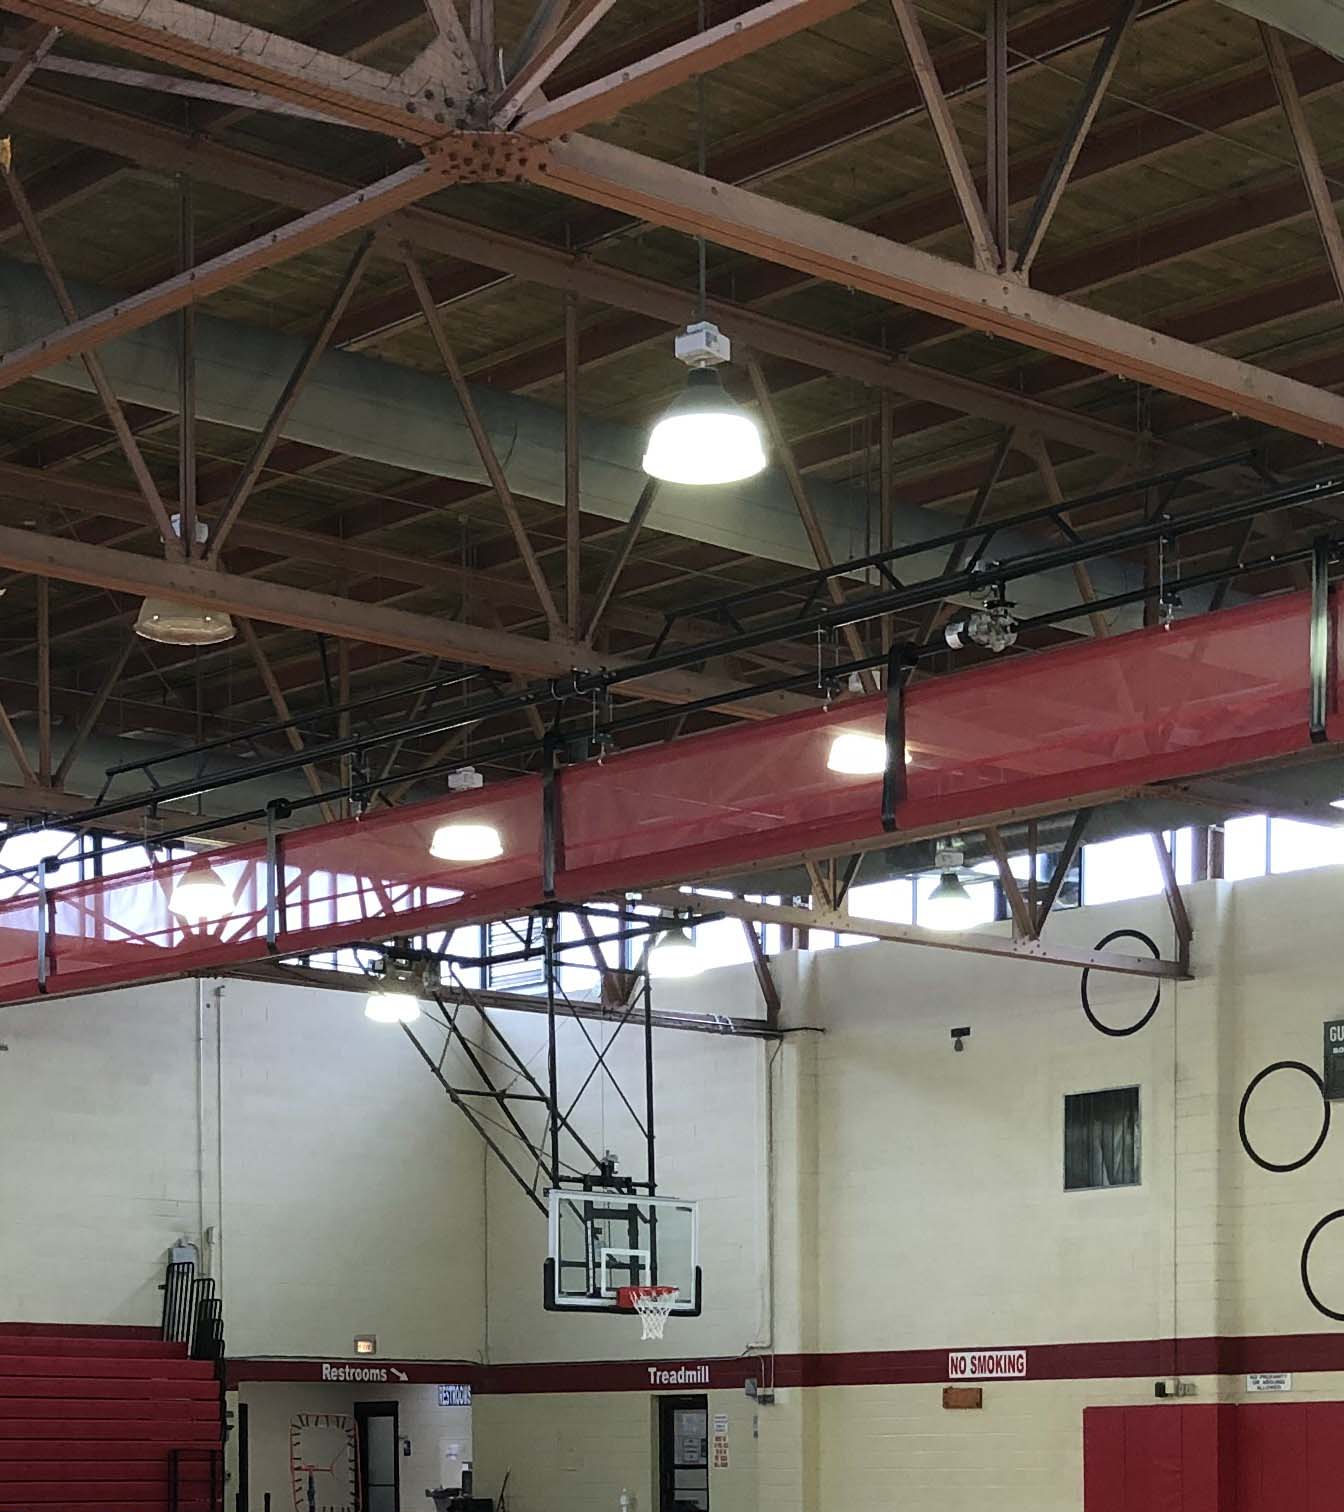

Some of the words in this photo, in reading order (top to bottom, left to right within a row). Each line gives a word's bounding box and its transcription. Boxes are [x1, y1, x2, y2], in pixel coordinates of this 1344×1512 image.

[322, 1363, 387, 1382] Restrooms
[950, 1356, 967, 1375] NO
[970, 1354, 1024, 1375] SMOKING
[647, 1365, 709, 1384] Treadmill
